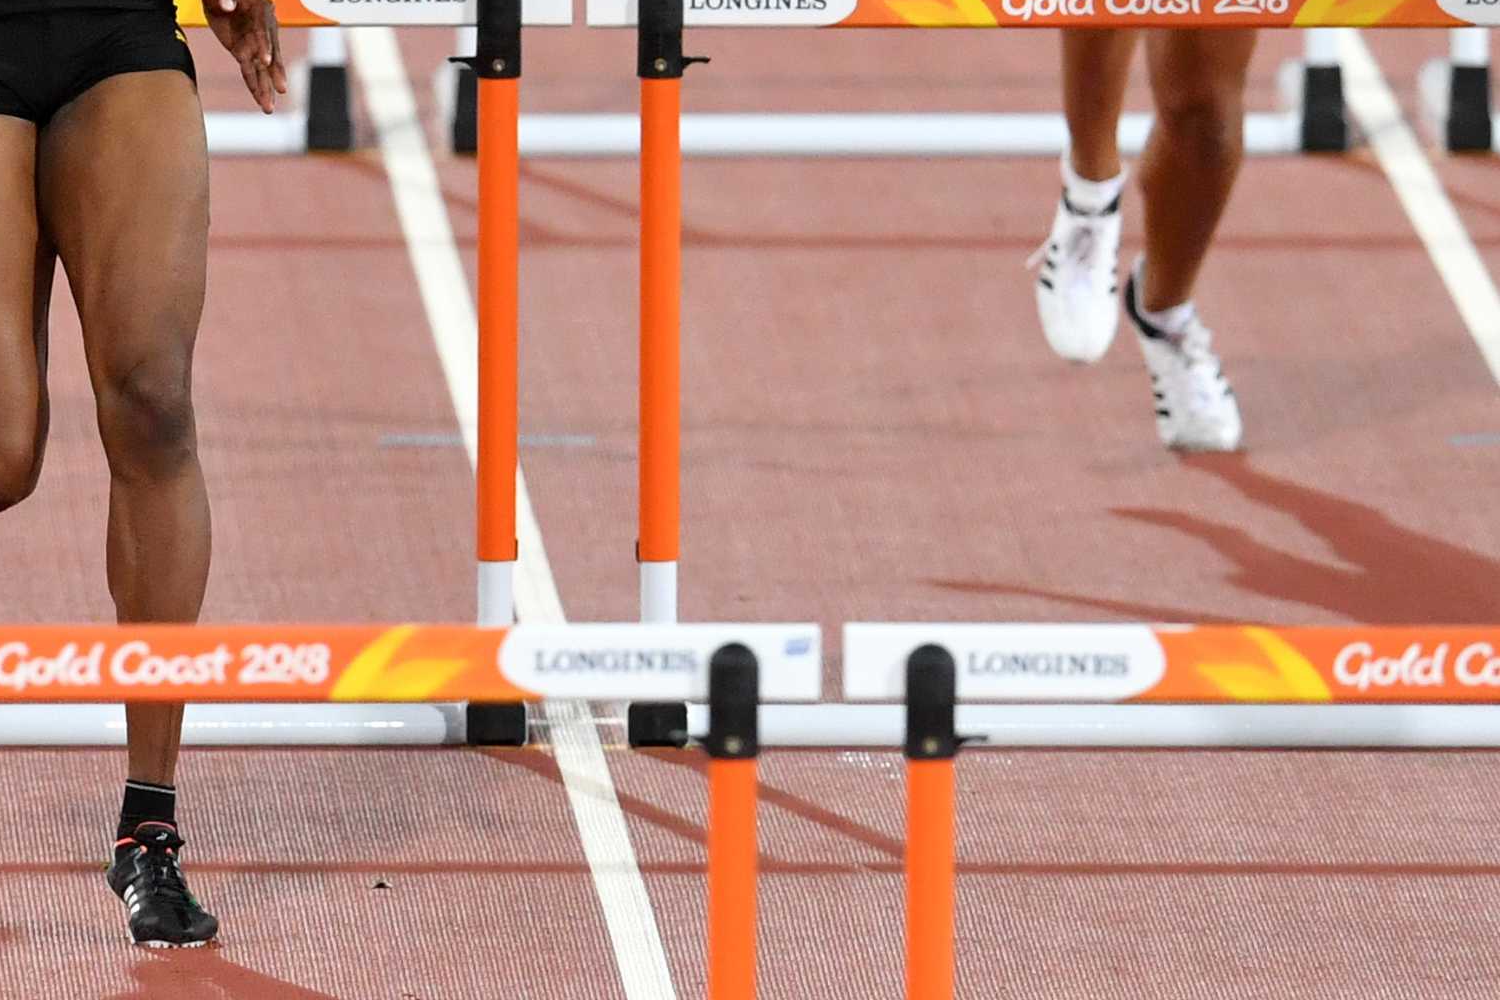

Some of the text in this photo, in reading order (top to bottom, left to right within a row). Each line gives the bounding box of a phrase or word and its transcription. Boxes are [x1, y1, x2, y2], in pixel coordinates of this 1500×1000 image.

[110, 641, 232, 686] Coast
[238, 643, 331, 685] 2018
[534, 649, 697, 674] LONGINES
[967, 651, 1130, 676] LONGINES
[1333, 641, 1450, 691] Gold
